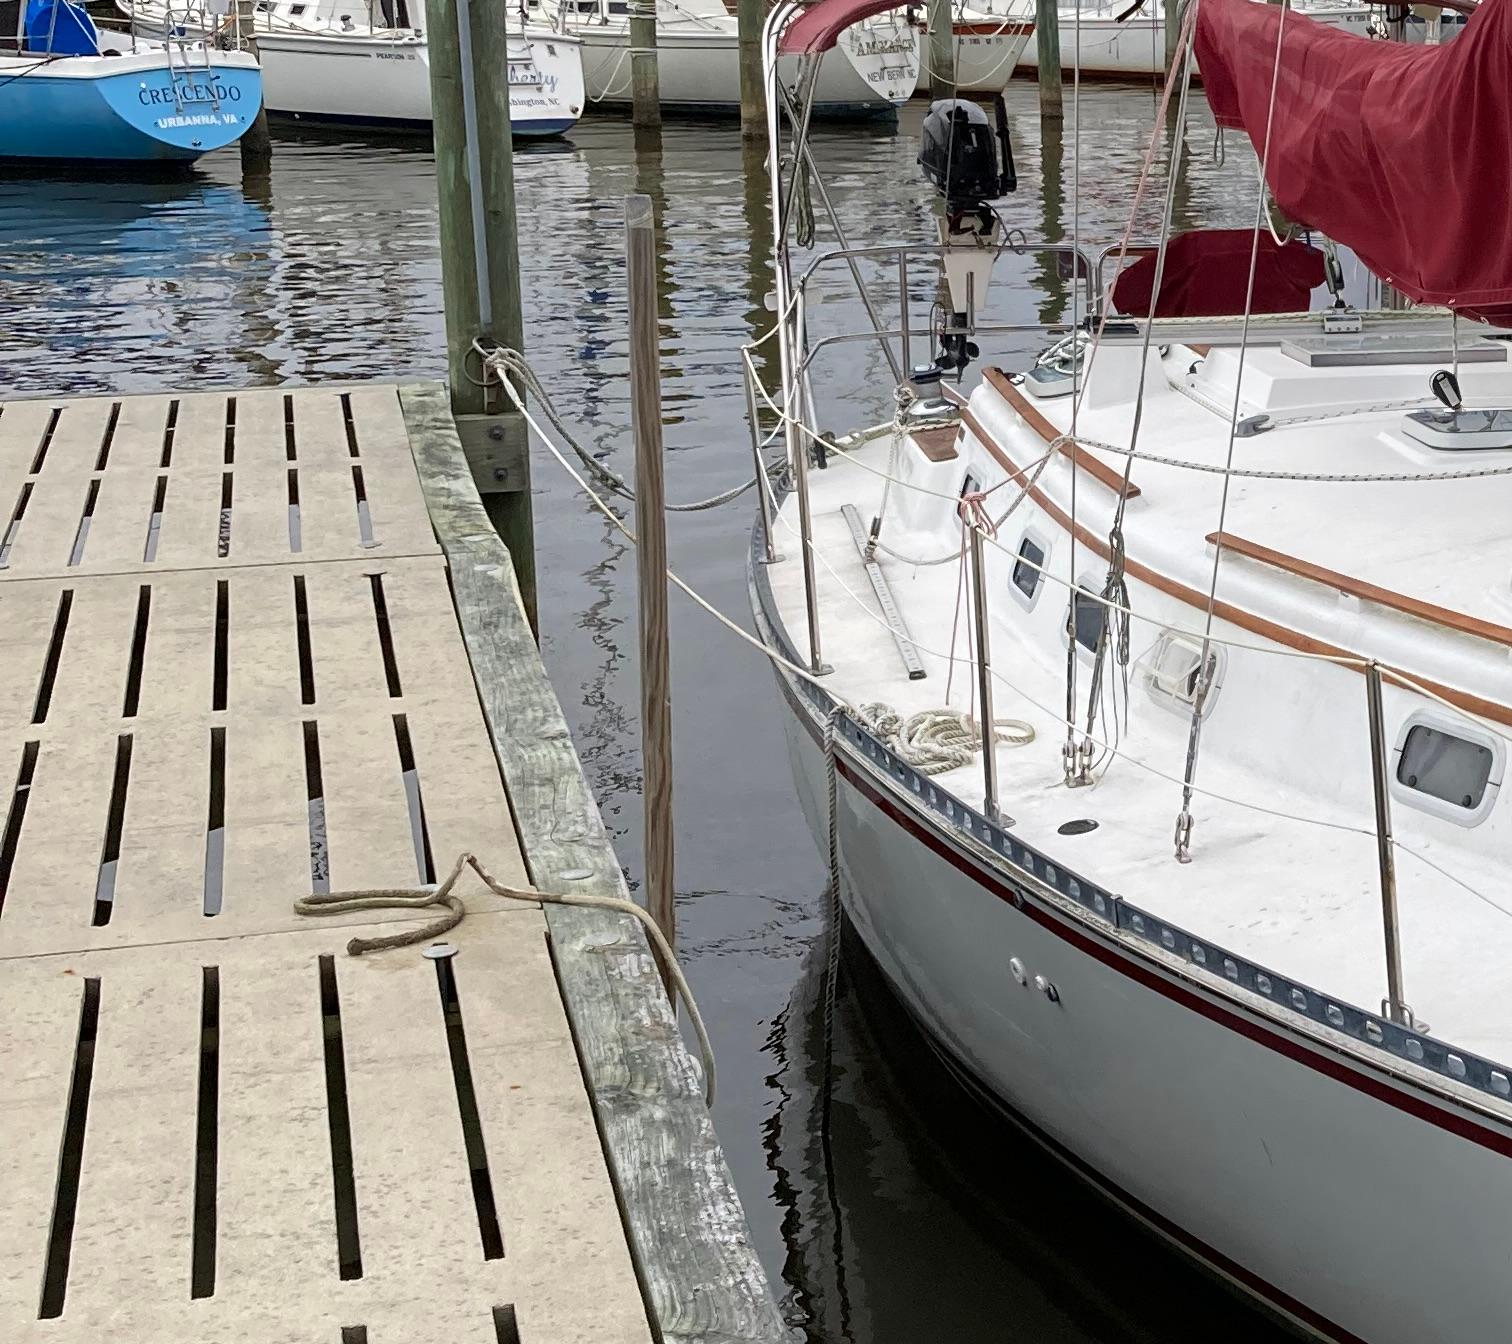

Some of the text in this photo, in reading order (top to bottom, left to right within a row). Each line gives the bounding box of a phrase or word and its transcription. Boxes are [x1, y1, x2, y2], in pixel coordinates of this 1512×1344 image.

[139, 85, 241, 106] CRESCENDO
[548, 98, 560, 106] NC
[158, 114, 238, 129] URBANNA, VA
